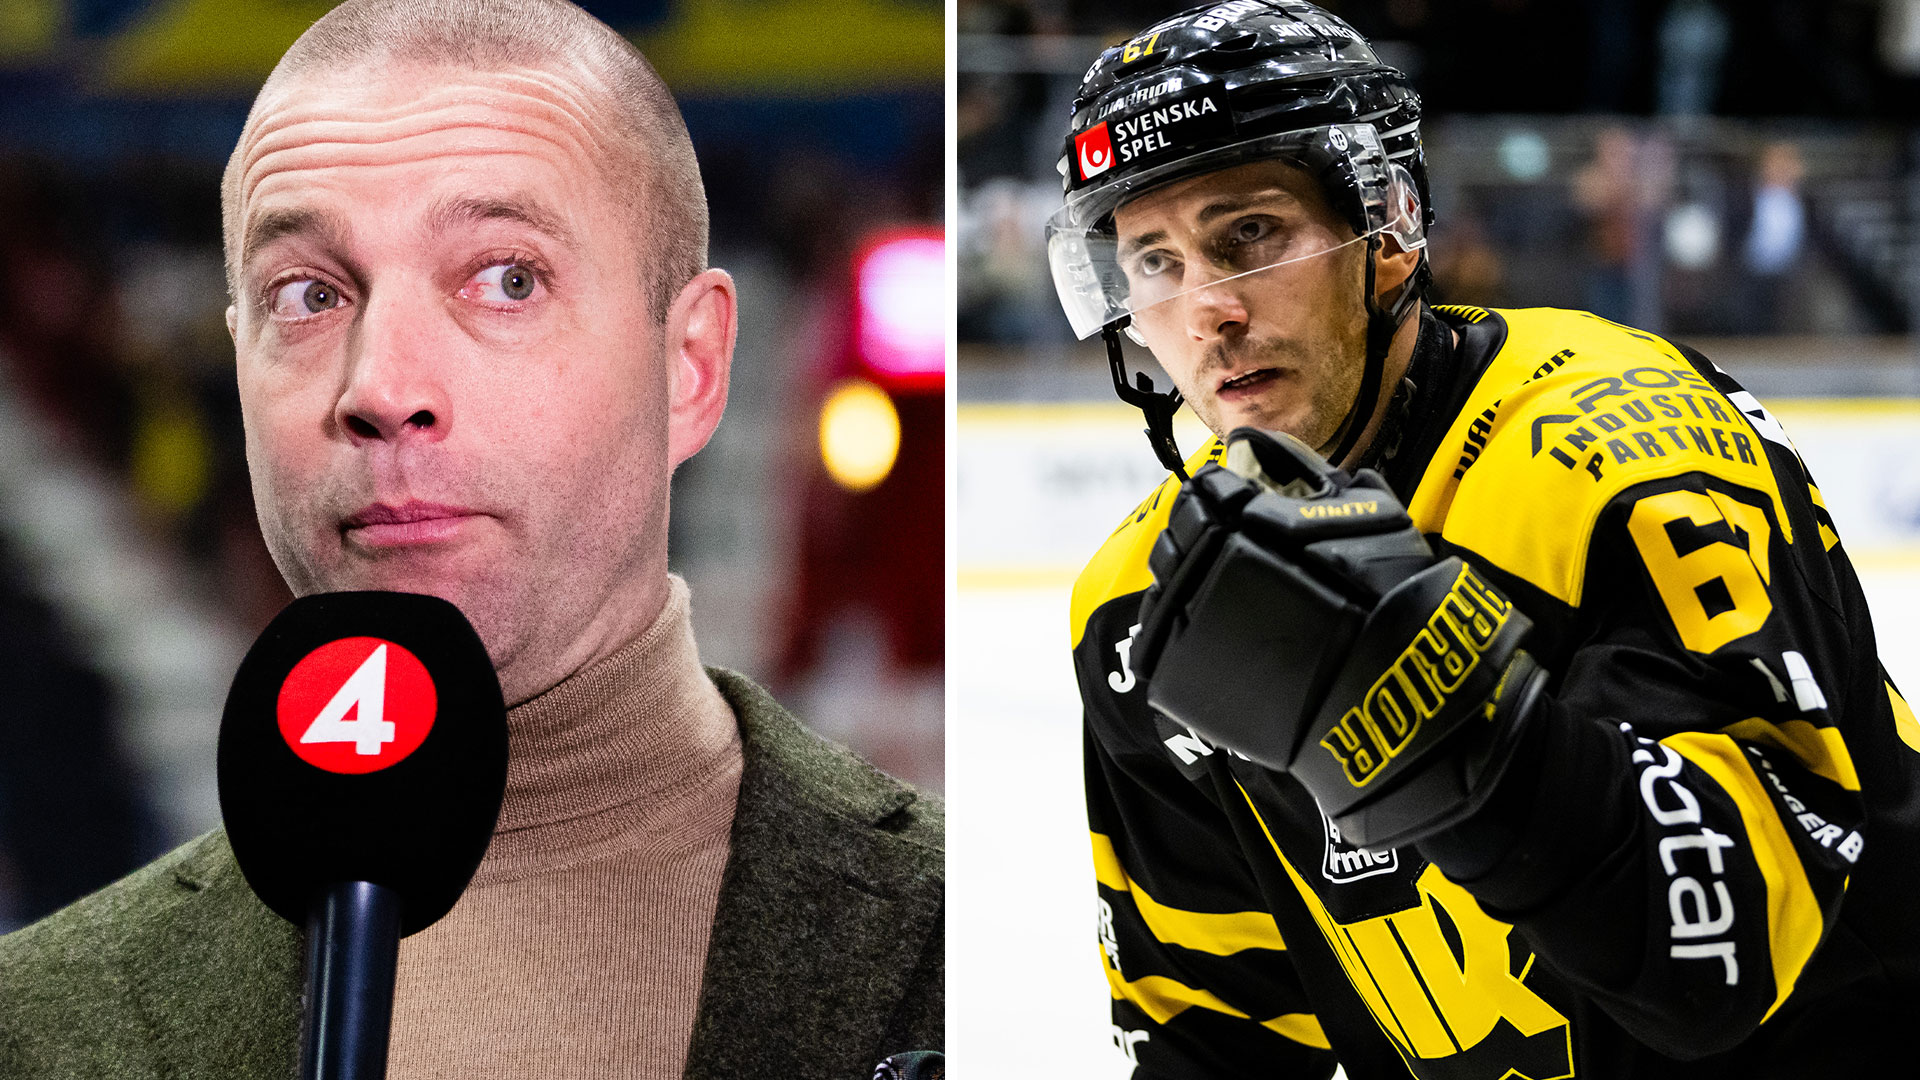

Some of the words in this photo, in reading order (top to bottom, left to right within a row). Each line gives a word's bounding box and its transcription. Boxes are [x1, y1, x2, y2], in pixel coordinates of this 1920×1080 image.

[1122, 33, 1160, 63] 67
[1098, 77, 1183, 120] WARRIOR
[1114, 96, 1218, 142] SVENSKA
[1119, 131, 1172, 163] SPEL
[1549, 394, 1744, 471] INDUSTR
[1585, 425, 1759, 482] PARTNER
[1627, 489, 1773, 655] 67
[299, 642, 396, 756] 4
